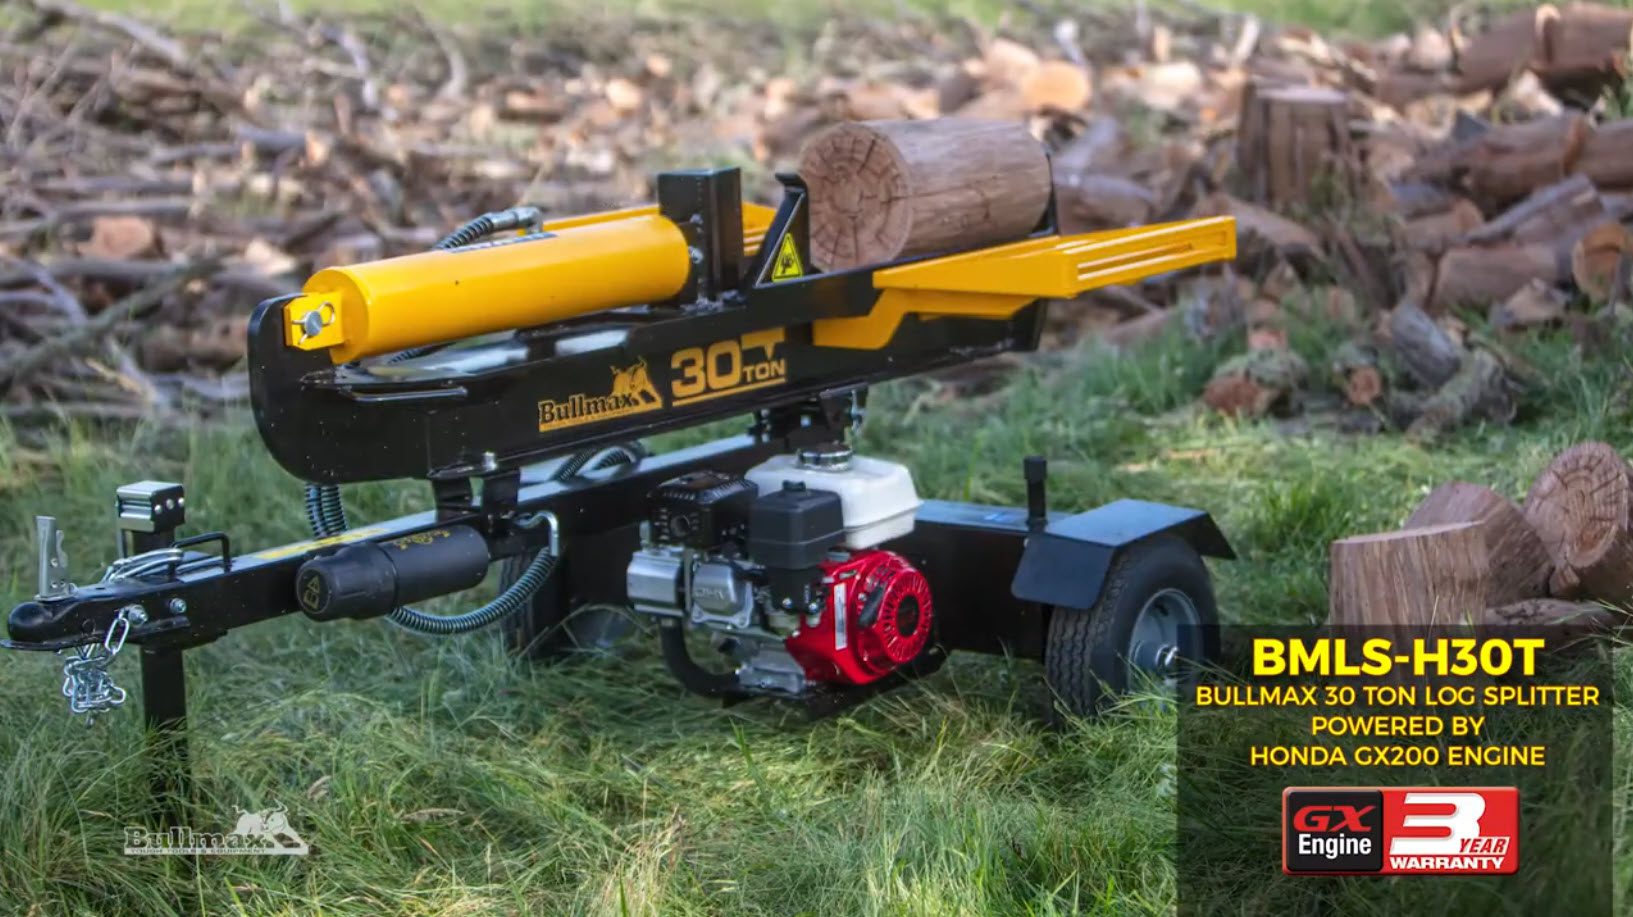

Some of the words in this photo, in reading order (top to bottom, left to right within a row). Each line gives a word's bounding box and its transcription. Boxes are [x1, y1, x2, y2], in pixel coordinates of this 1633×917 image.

[671, 340, 742, 399] 30
[743, 358, 786, 382] TON
[538, 392, 638, 424] Bullmax
